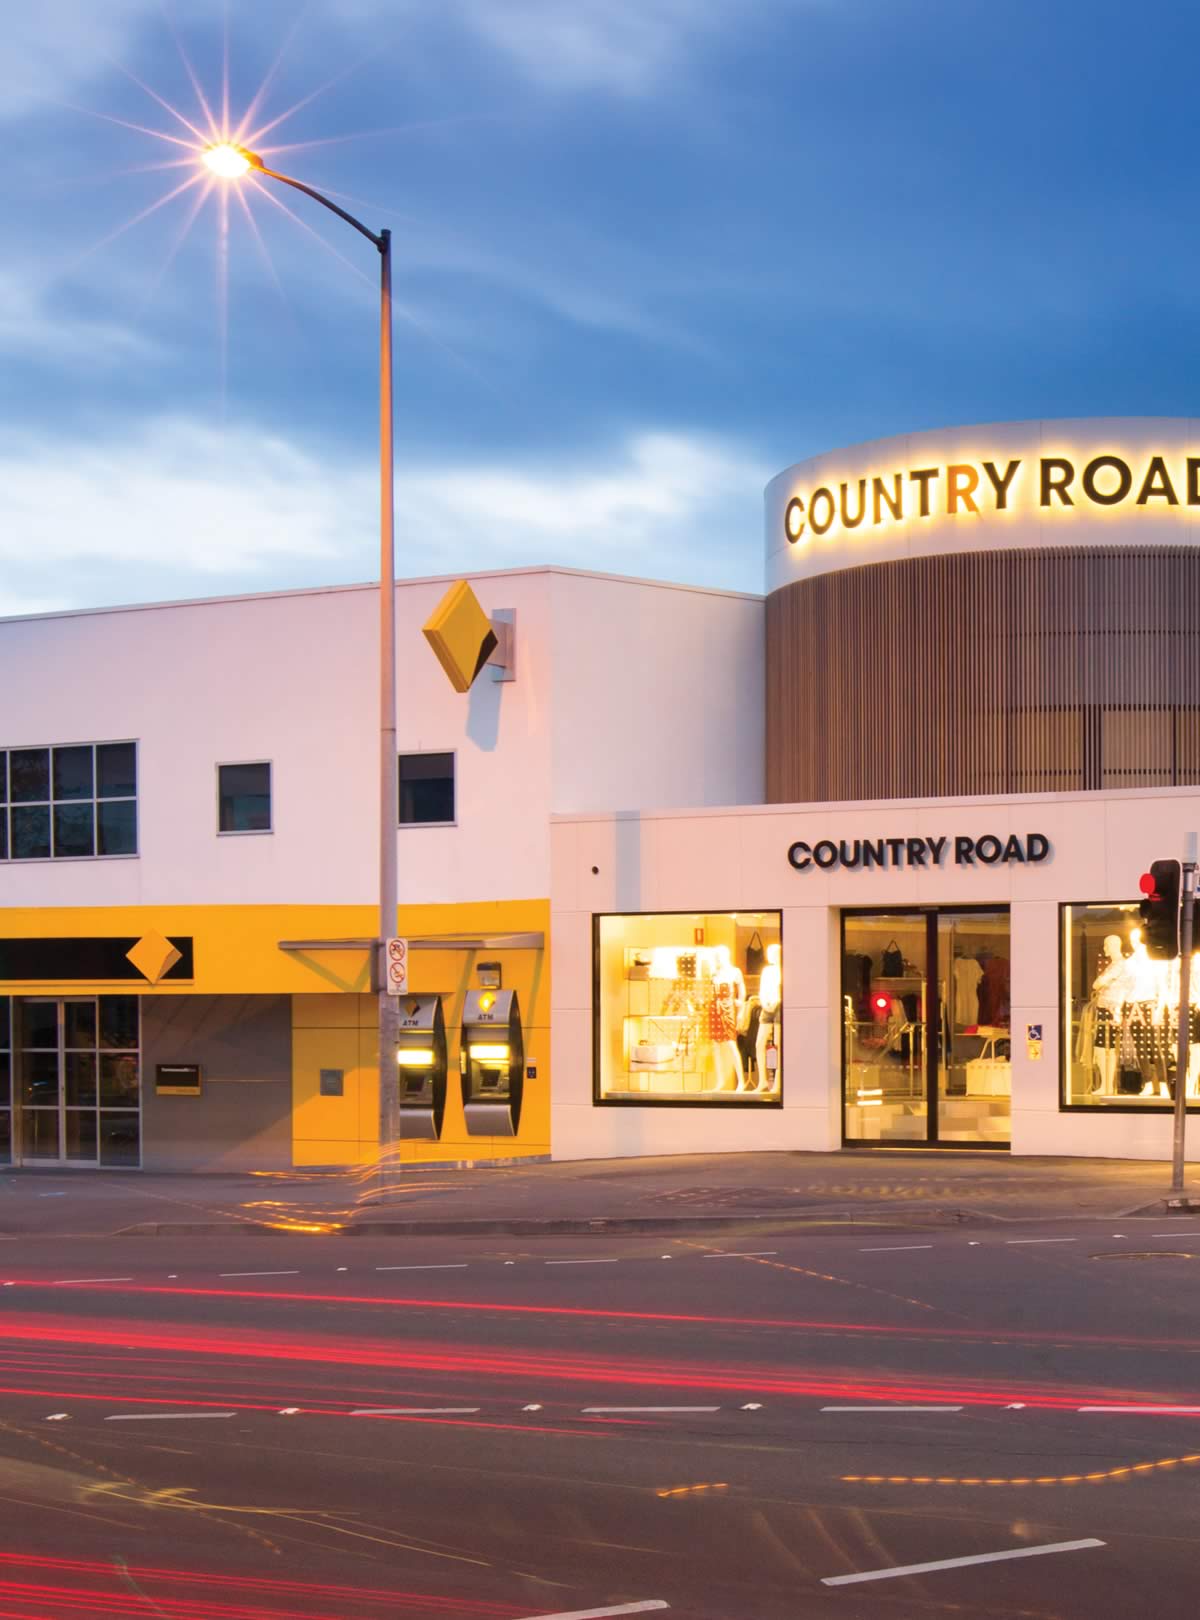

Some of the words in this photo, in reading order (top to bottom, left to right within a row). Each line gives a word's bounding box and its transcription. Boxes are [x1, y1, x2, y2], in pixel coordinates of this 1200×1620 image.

[785, 459, 1022, 545] COUNTRY
[787, 836, 947, 870] COUNTRY
[954, 833, 1050, 865] ROAD
[478, 1013, 494, 1021] ATM
